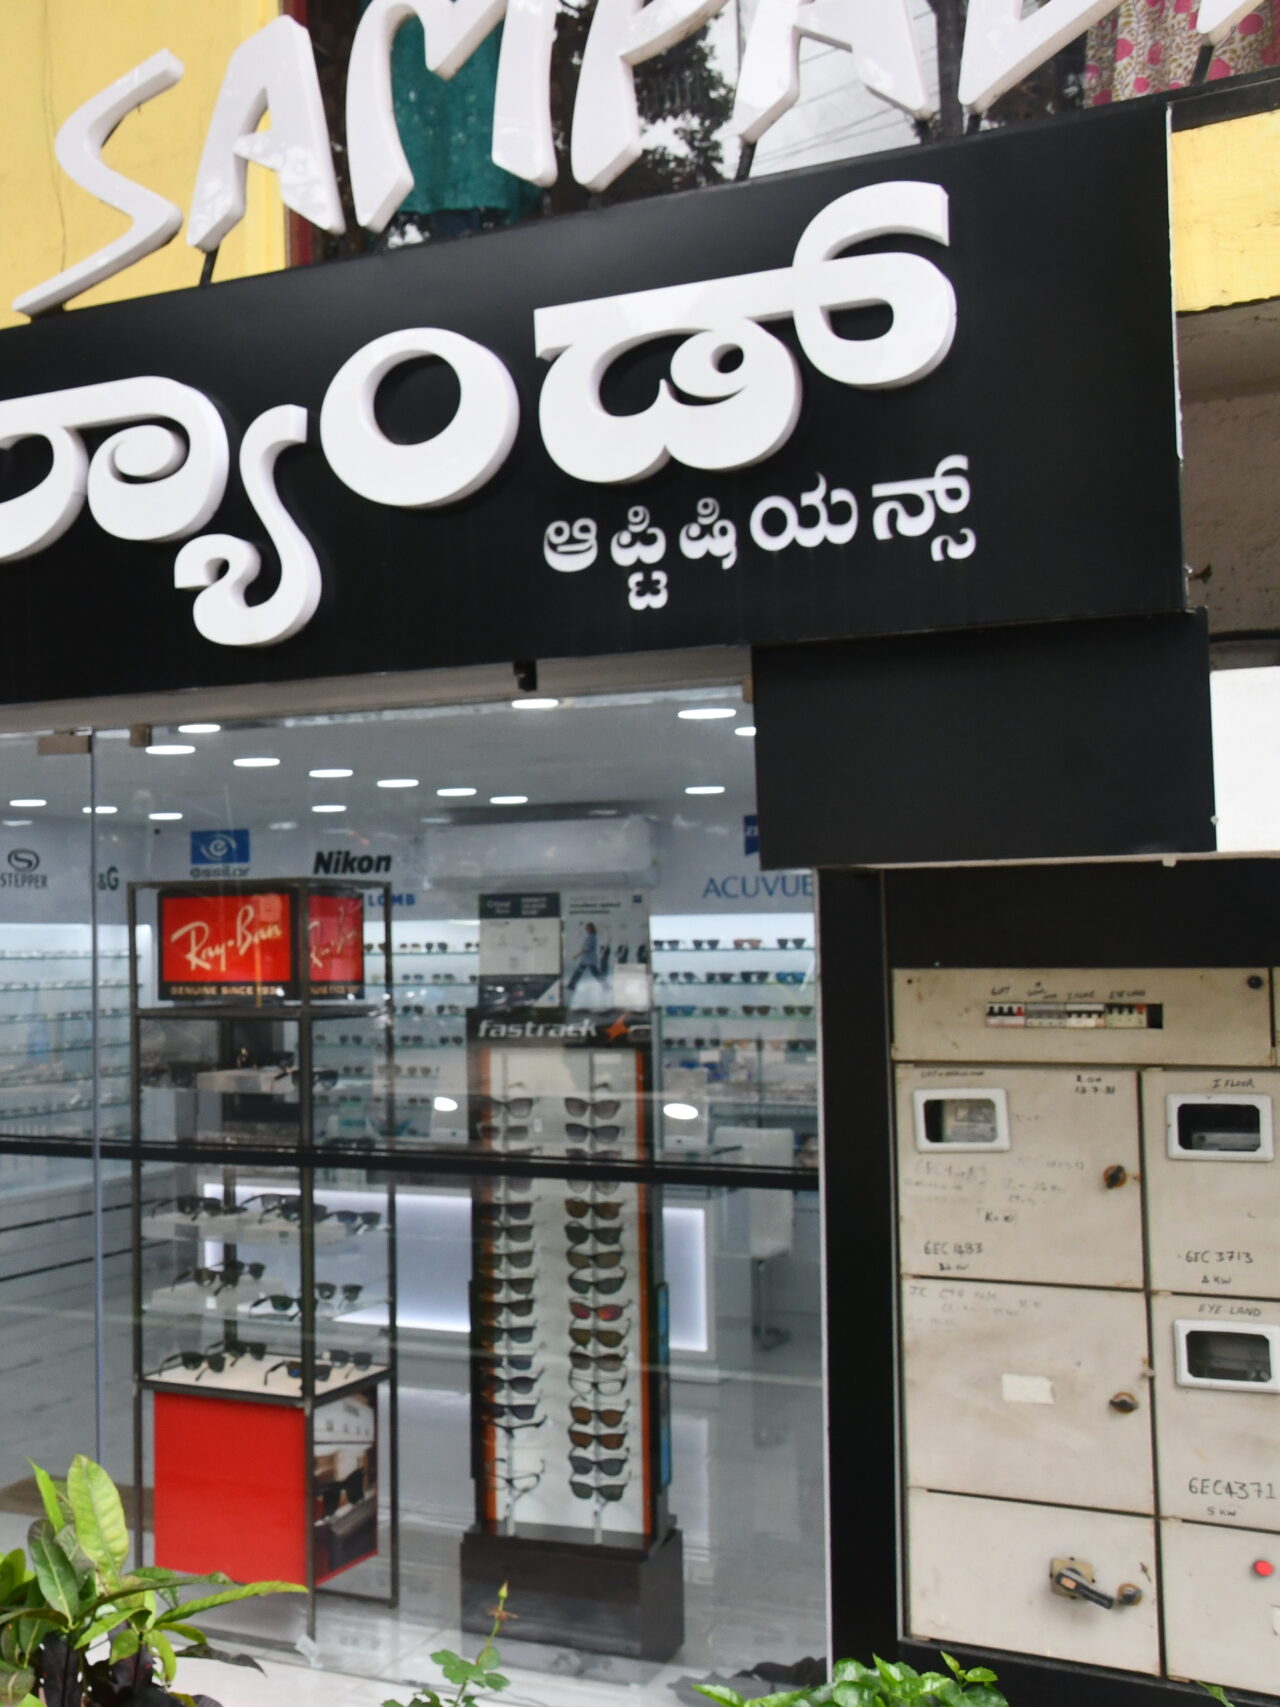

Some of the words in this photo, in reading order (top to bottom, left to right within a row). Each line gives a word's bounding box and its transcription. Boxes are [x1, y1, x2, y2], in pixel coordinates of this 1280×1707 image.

[13, 0, 1267, 317] SAMPA
[190, 865, 251, 879] essilor
[313, 850, 392, 875] Nikon
[0, 872, 48, 889] STEPPER
[703, 874, 813, 898] ACUVUE
[171, 905, 282, 971] Ray-Ban
[478, 1018, 597, 1038] fastrack
